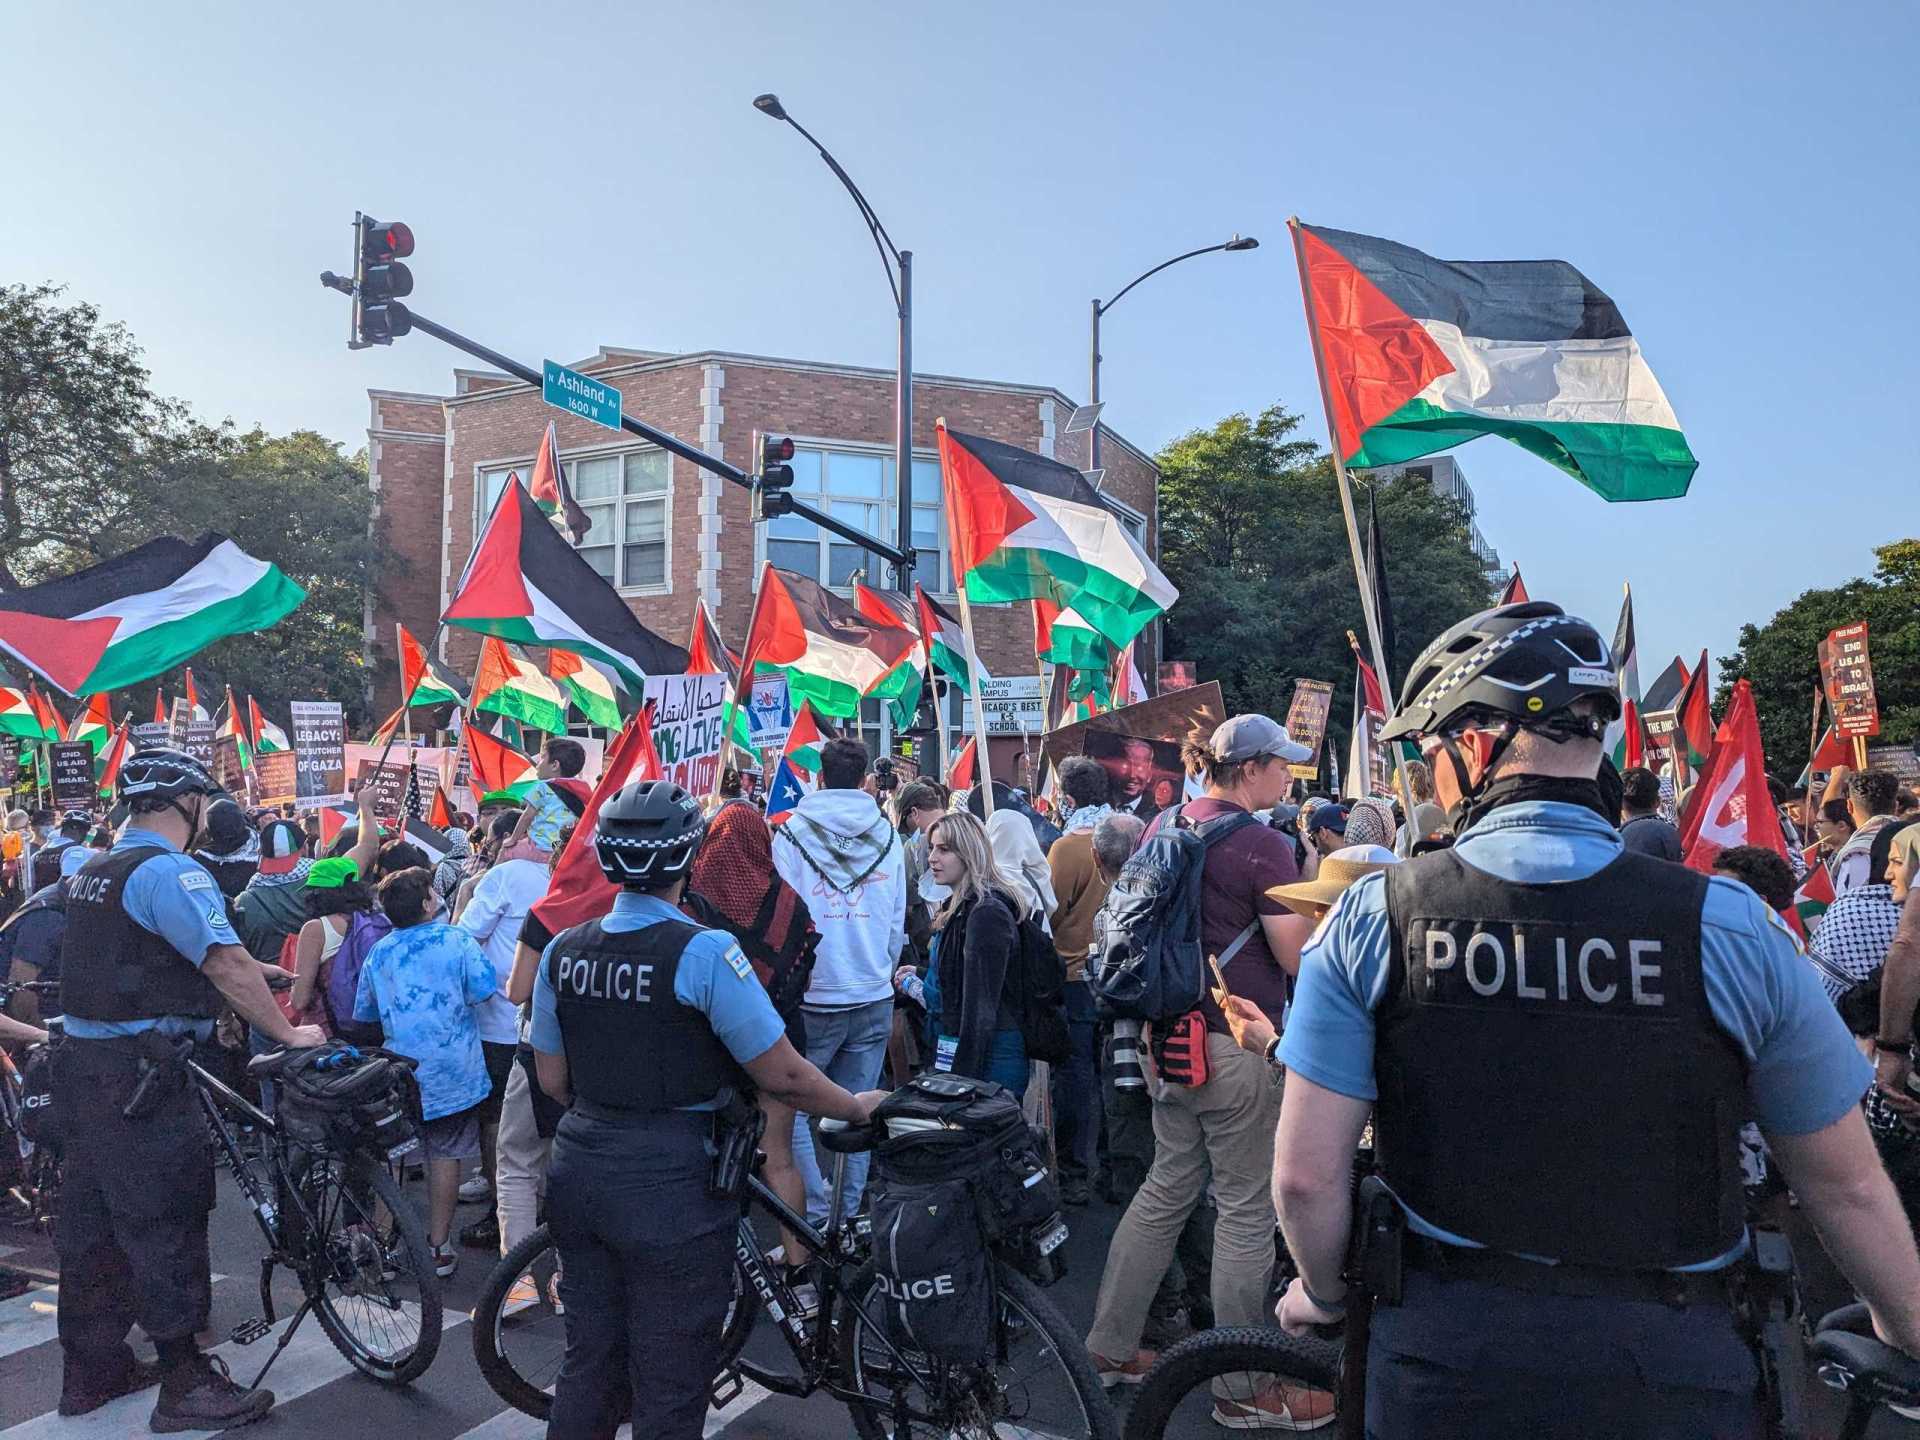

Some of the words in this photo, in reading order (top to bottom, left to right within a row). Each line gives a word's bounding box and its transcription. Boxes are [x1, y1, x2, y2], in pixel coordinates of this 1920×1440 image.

[548, 372, 554, 383] N
[558, 371, 605, 404] Ashland
[608, 399, 617, 409] Av
[568, 397, 589, 415] 1600
[591, 406, 599, 418] W
[1844, 641, 1861, 653] END
[1850, 669, 1862, 679] TO
[983, 680, 1012, 688] ALDING
[1841, 681, 1870, 694] ISRAEL
[980, 689, 1009, 697] AMPUS
[1021, 701, 1041, 711] BEST
[1001, 712, 1014, 721] K-5
[989, 722, 1019, 731] SCHOOL
[1647, 722, 1661, 734] THE
[295, 730, 341, 742] LEGACY:
[683, 715, 721, 759] LIVE
[308, 747, 342, 755] BUTCHER
[297, 760, 309, 772] OF
[311, 759, 343, 771] GAZA
[57, 776, 89, 784] ISRAEL
[382, 780, 400, 788] AID
[1425, 930, 1665, 1007] POLICE
[558, 956, 654, 1002] POLICE
